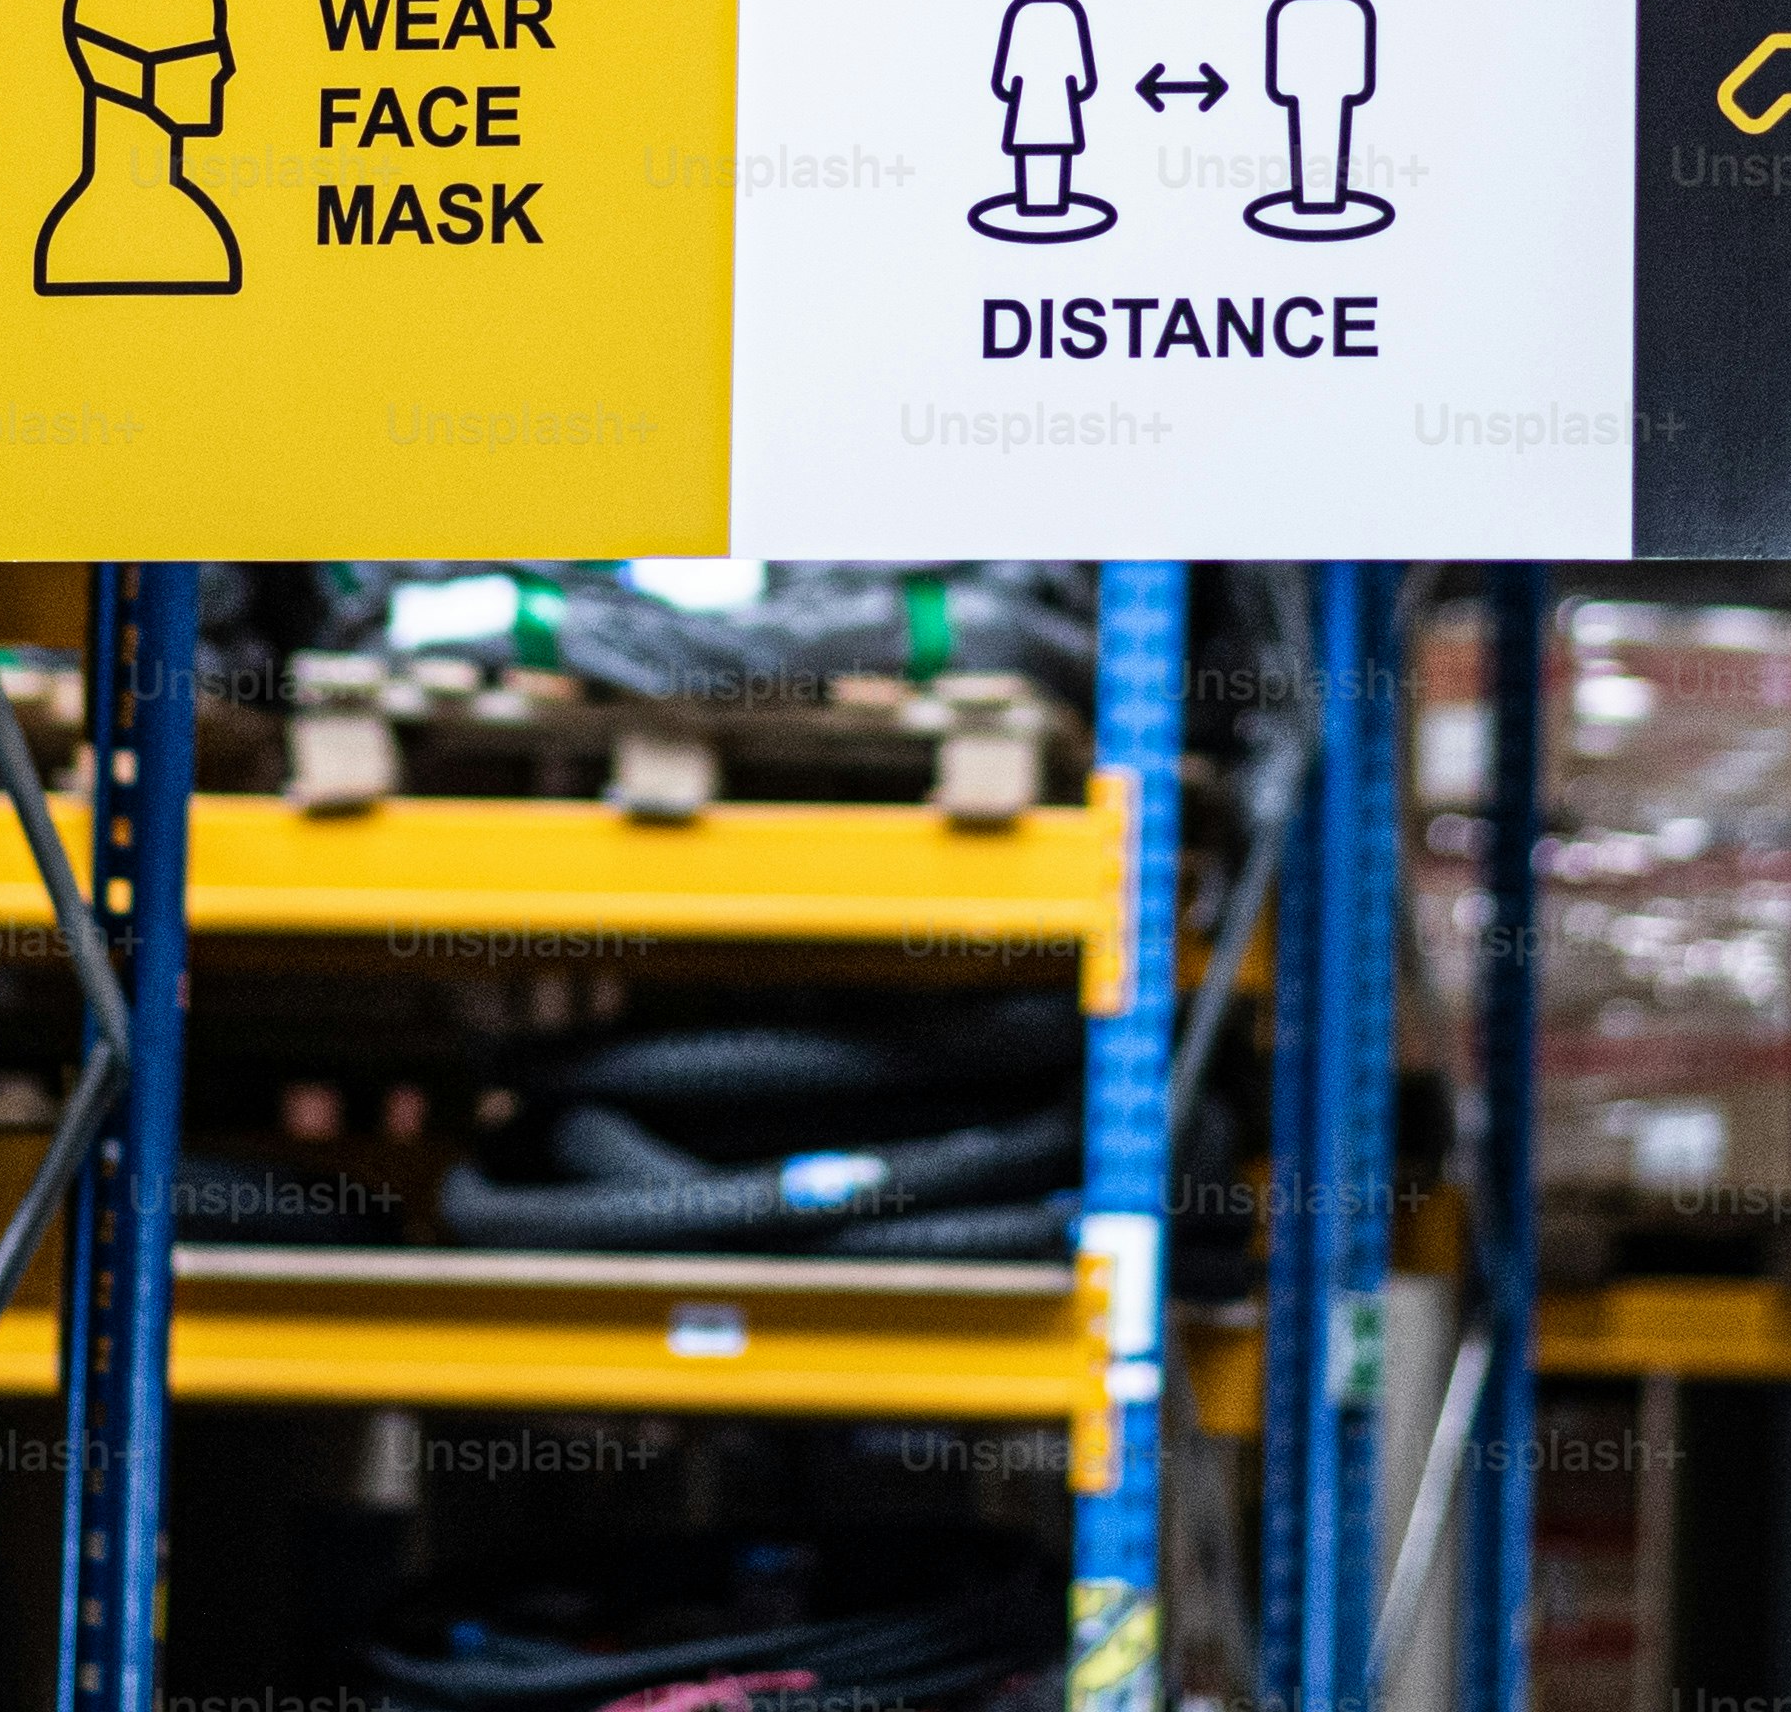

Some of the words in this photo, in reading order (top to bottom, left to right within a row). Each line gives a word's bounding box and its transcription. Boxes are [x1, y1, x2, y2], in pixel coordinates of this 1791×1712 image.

[319, 86, 521, 149] FACE
[316, 183, 543, 246] MASK
[983, 296, 1379, 359] DISTANCE
